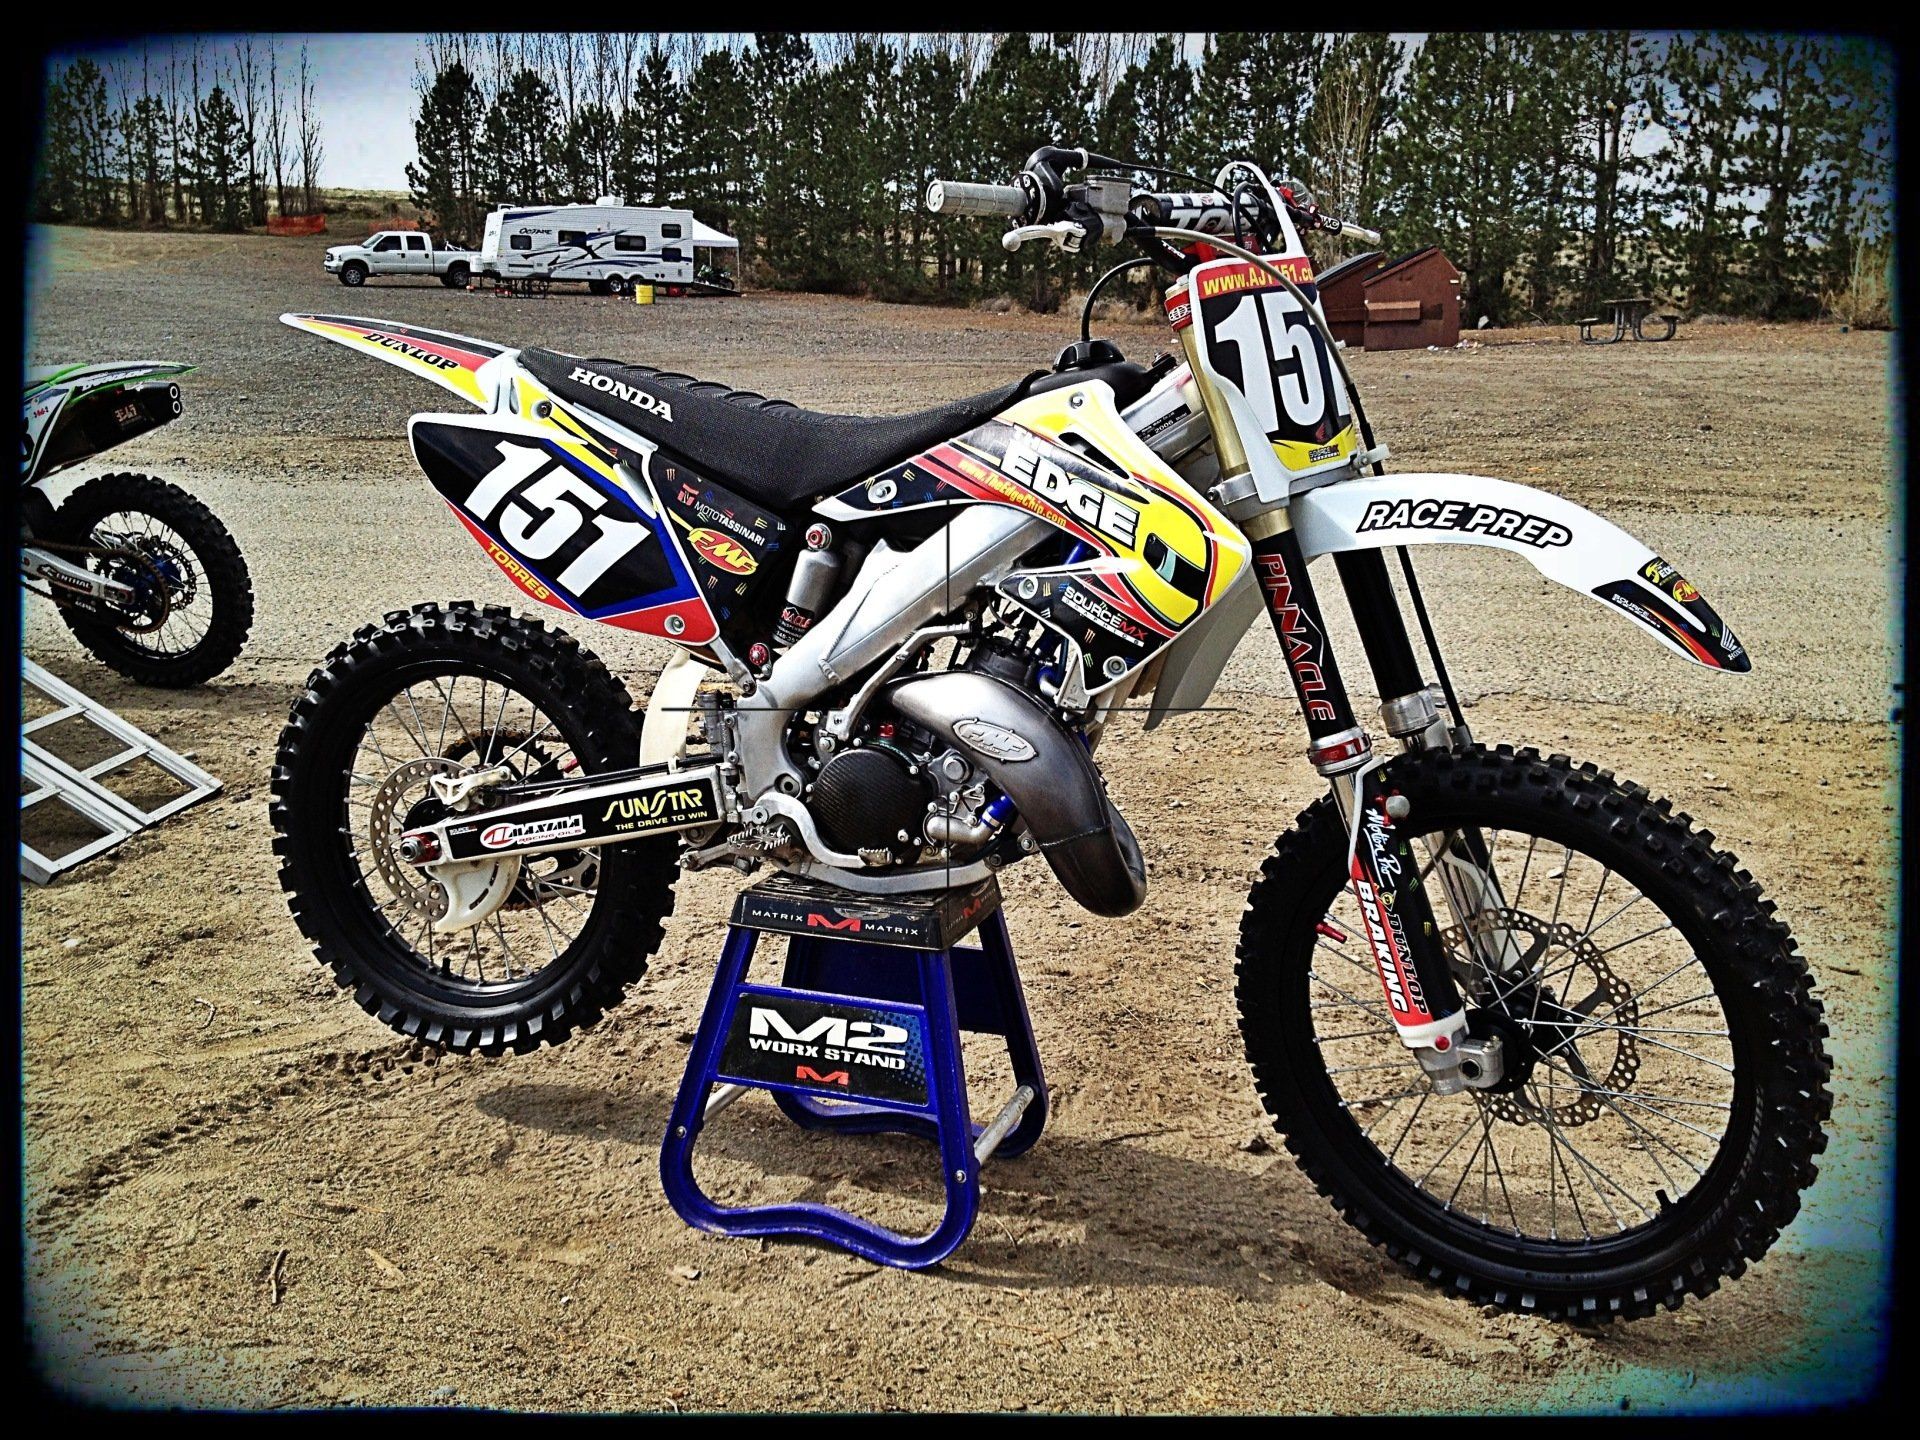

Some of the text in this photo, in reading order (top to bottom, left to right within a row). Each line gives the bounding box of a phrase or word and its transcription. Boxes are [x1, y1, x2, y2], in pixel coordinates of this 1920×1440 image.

[363, 333, 458, 369] DUNLOP
[568, 367, 673, 422] HONDA
[958, 460, 1067, 527] www.TheEdgeChip.com
[1001, 440, 1140, 552] EDGE
[464, 440, 651, 597] 151
[694, 501, 765, 546] MOTOTASSINARI
[1359, 500, 1571, 547] RACE PREP
[487, 542, 550, 600] TORRES
[687, 530, 759, 571] FMF
[1064, 586, 1148, 640] SOURCEMX
[1257, 554, 1336, 720] PINNACLE
[508, 818, 581, 838] MAXIMA
[602, 790, 703, 821] SUNSTAR
[615, 823, 634, 831] THE
[638, 817, 668, 828] DRIVE
[687, 811, 708, 819] WIN
[752, 910, 803, 922] MATRIX
[865, 924, 919, 936] MATRIX
[1357, 880, 1409, 1013] BRAKING
[1386, 913, 1429, 1016] DUNLOP
[749, 1037, 906, 1070] WORX STAND
[750, 1007, 908, 1056] M2
